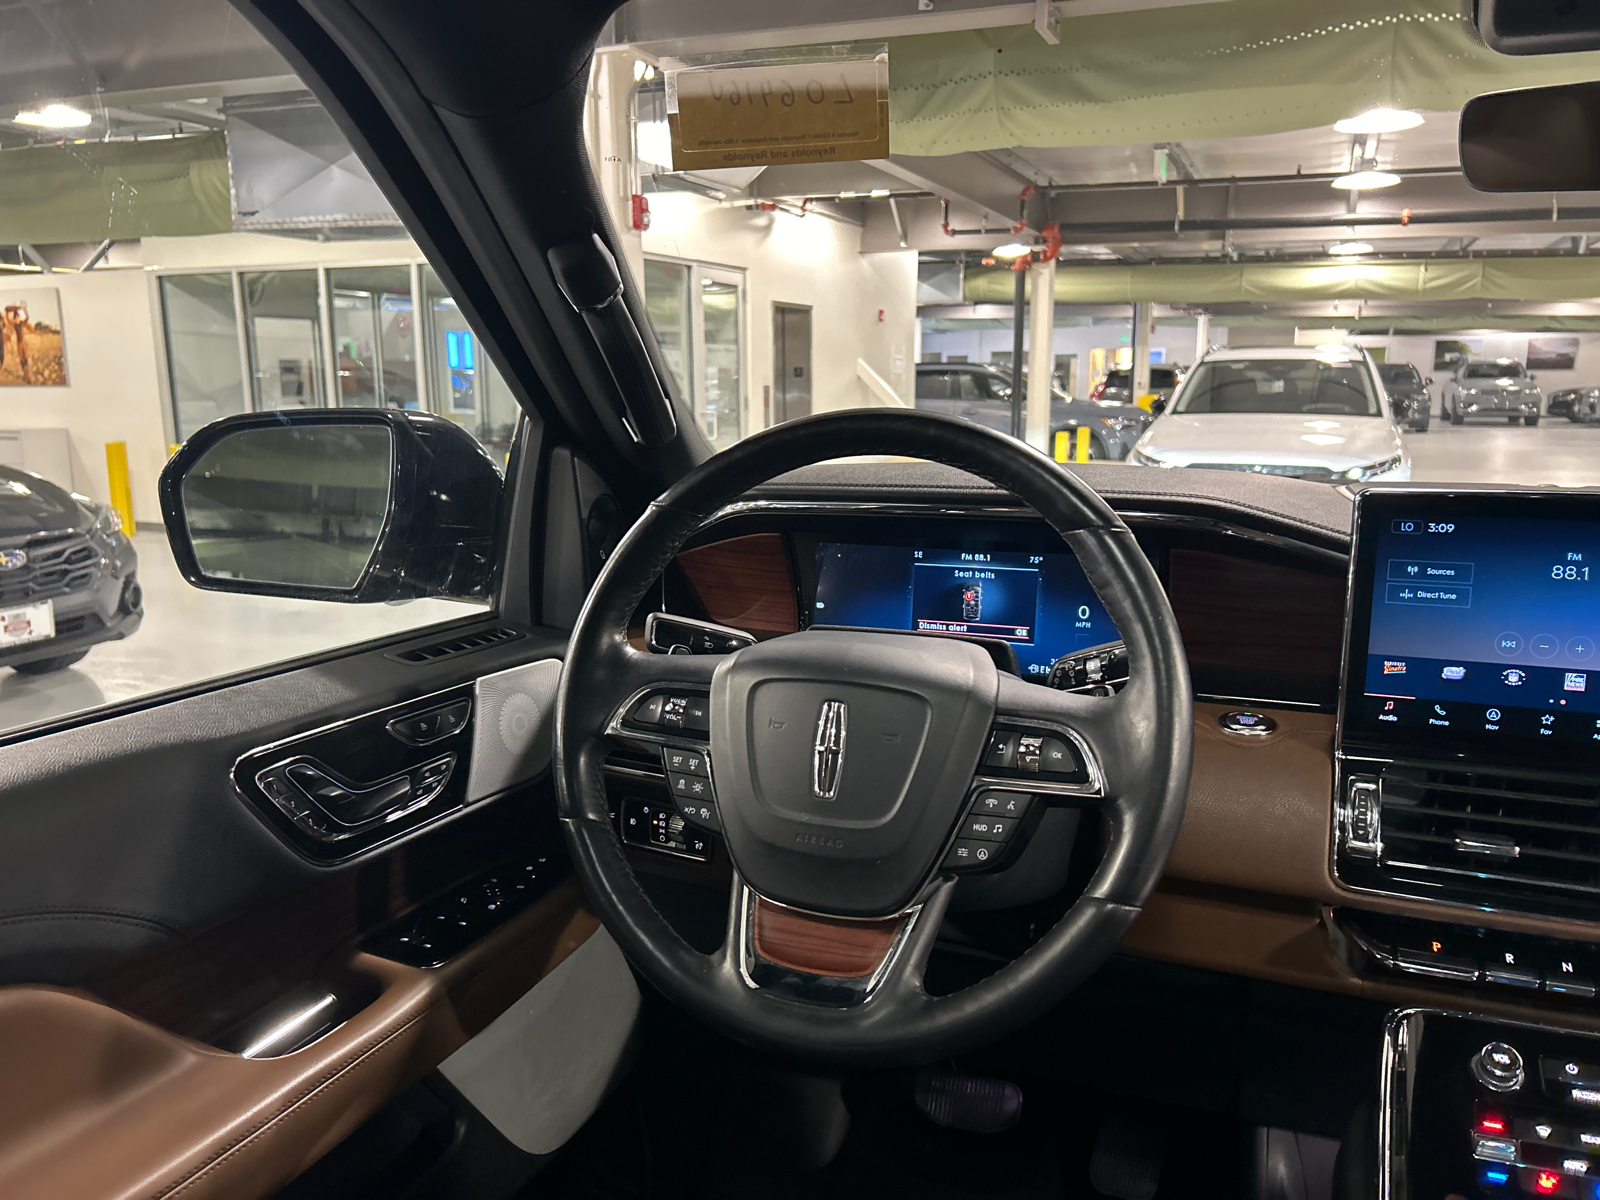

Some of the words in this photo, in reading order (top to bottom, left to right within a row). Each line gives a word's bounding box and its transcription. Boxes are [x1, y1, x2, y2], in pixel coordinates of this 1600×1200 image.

[1400, 522, 1414, 532] LO
[1427, 523, 1455, 533] 3:09
[974, 553, 991, 561] 88.1
[1567, 552, 1582, 561] FM
[954, 569, 973, 578] Seat
[973, 570, 995, 579] belts
[1426, 567, 1455, 576] Sources
[1551, 564, 1590, 581] 88.1
[1417, 590, 1439, 599] Direct
[1439, 591, 1457, 600] Tune
[918, 621, 947, 631] Dismiss
[948, 623, 968, 632] alert
[1075, 621, 1091, 629] MPH
[1378, 714, 1398, 722] Audio
[1429, 718, 1449, 727] Phone
[1540, 728, 1552, 736] Fav
[672, 755, 682, 763] SET
[972, 824, 988, 832] HUD
[795, 833, 844, 849] AIRBAG
[1432, 941, 1441, 951] P
[1505, 953, 1514, 964] R
[1562, 961, 1573, 973] N
[1492, 1052, 1511, 1064] VOL
